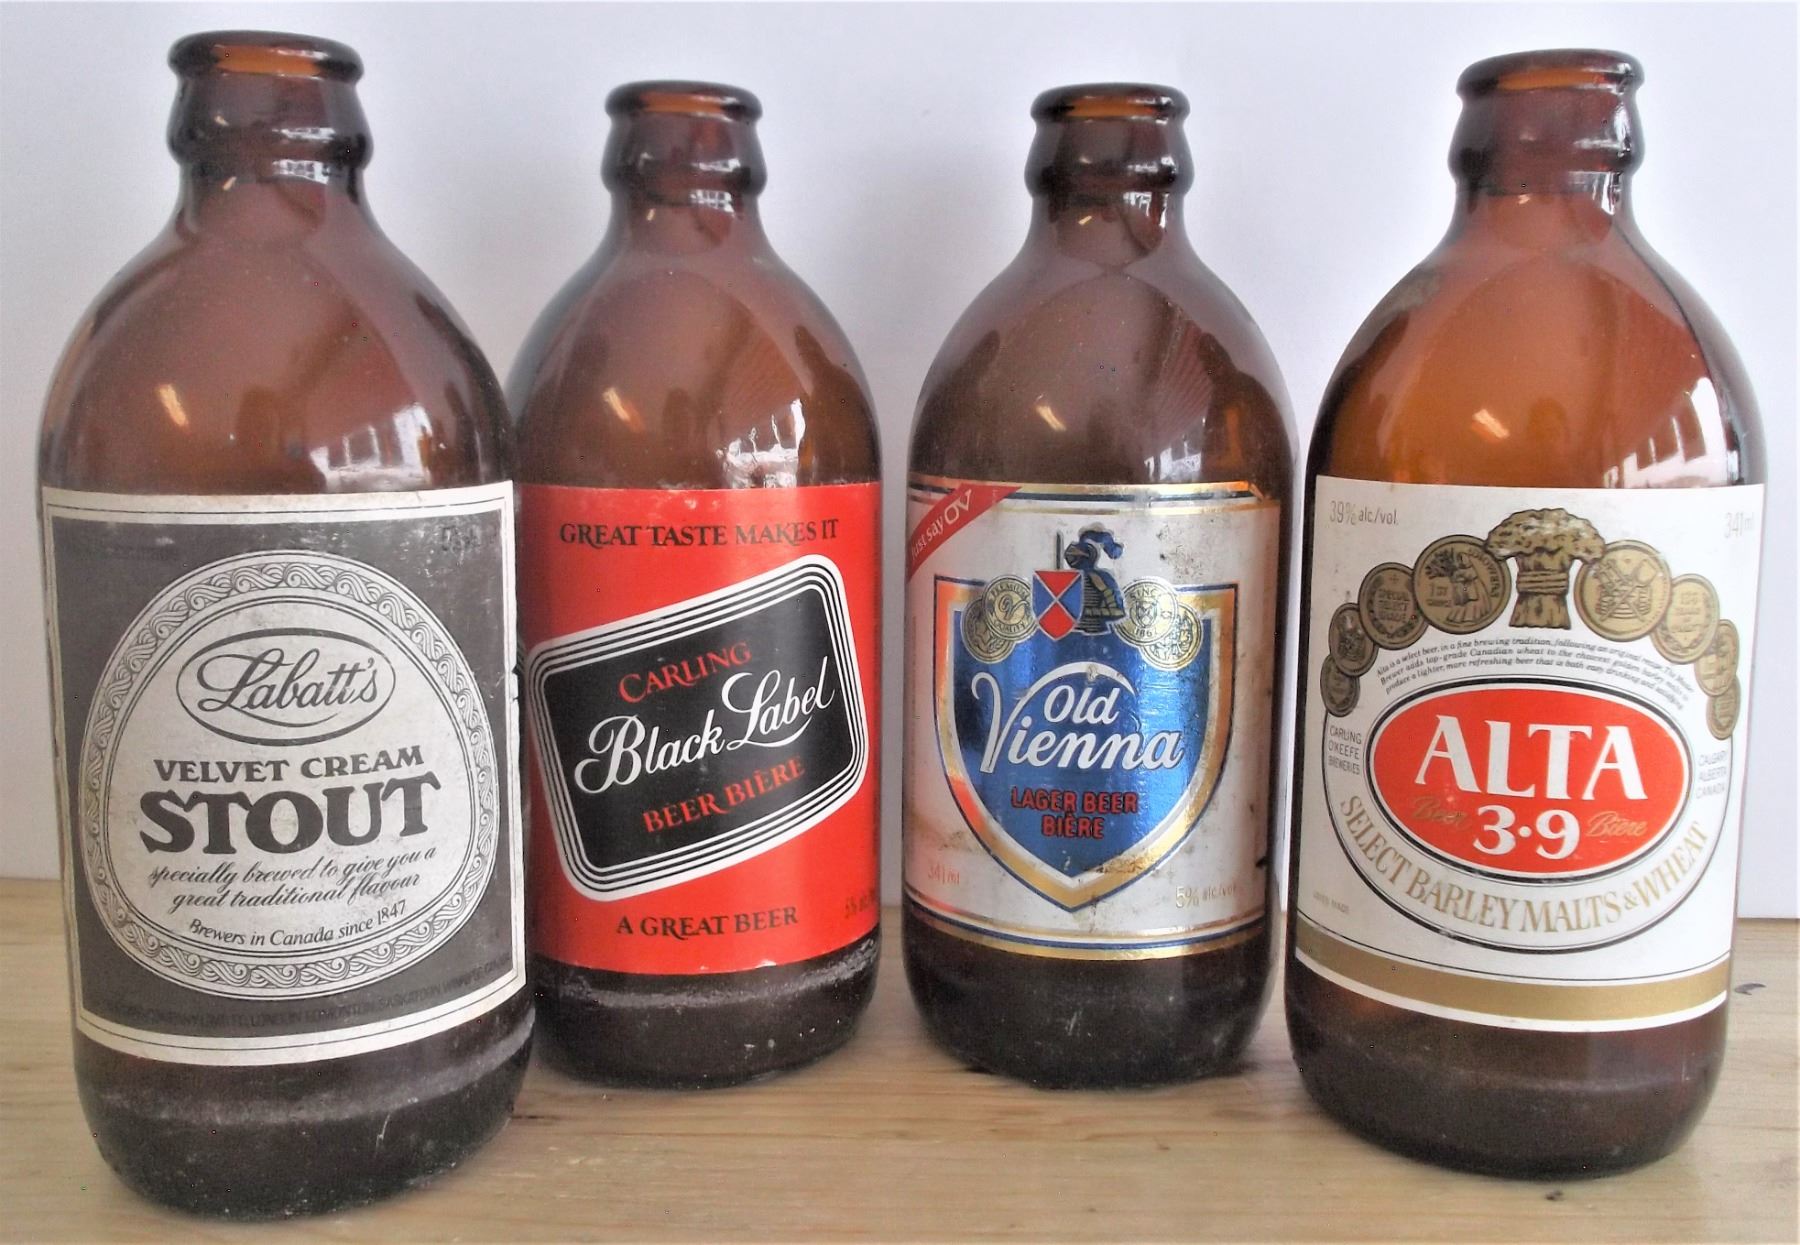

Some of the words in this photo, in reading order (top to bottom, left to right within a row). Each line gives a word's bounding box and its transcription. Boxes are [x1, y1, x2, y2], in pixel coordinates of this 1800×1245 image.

[559, 524, 638, 550] GREAT
[646, 524, 726, 547] TASTE
[735, 520, 817, 547] MAKES
[821, 518, 838, 540] IT
[925, 515, 943, 542] say
[943, 488, 973, 525] OV
[197, 648, 379, 716] Labatt's
[618, 642, 752, 704] CARLING
[574, 704, 726, 795] Black
[721, 655, 836, 750] Label
[971, 662, 1185, 774] Vienna
[1044, 685, 1119, 726] Old
[1329, 725, 1363, 745] CARLING
[1414, 714, 1649, 801] ALTA
[153, 759, 290, 784] VELVET
[301, 745, 425, 777] CREAM
[139, 771, 441, 856] STOUT
[642, 791, 725, 835] BEER
[1012, 786, 1077, 812] LAGER
[1082, 791, 1138, 813] BEER
[1041, 808, 1104, 840] BIÈRE
[149, 860, 238, 893] specially
[243, 856, 321, 885] brewed
[322, 858, 339, 878] to
[336, 854, 386, 886] give
[386, 851, 422, 875] you
[423, 846, 437, 861] a
[1340, 795, 1413, 886] SELECT
[1405, 867, 1520, 931] BARLEY
[1519, 890, 1623, 933] MALTS
[1623, 894, 1639, 911] &
[1631, 820, 1709, 908] WHEAT
[168, 889, 231, 915] great
[230, 877, 351, 908] traditional
[348, 873, 421, 905] flavour
[1175, 885, 1200, 909] 5%
[189, 918, 245, 945] Brewers
[250, 932, 265, 946] in
[269, 926, 334, 946] Canada
[338, 917, 372, 939] since
[377, 899, 407, 926] 1847
[615, 915, 634, 935] A
[639, 916, 727, 942] GREAT
[733, 906, 799, 934] BEER
